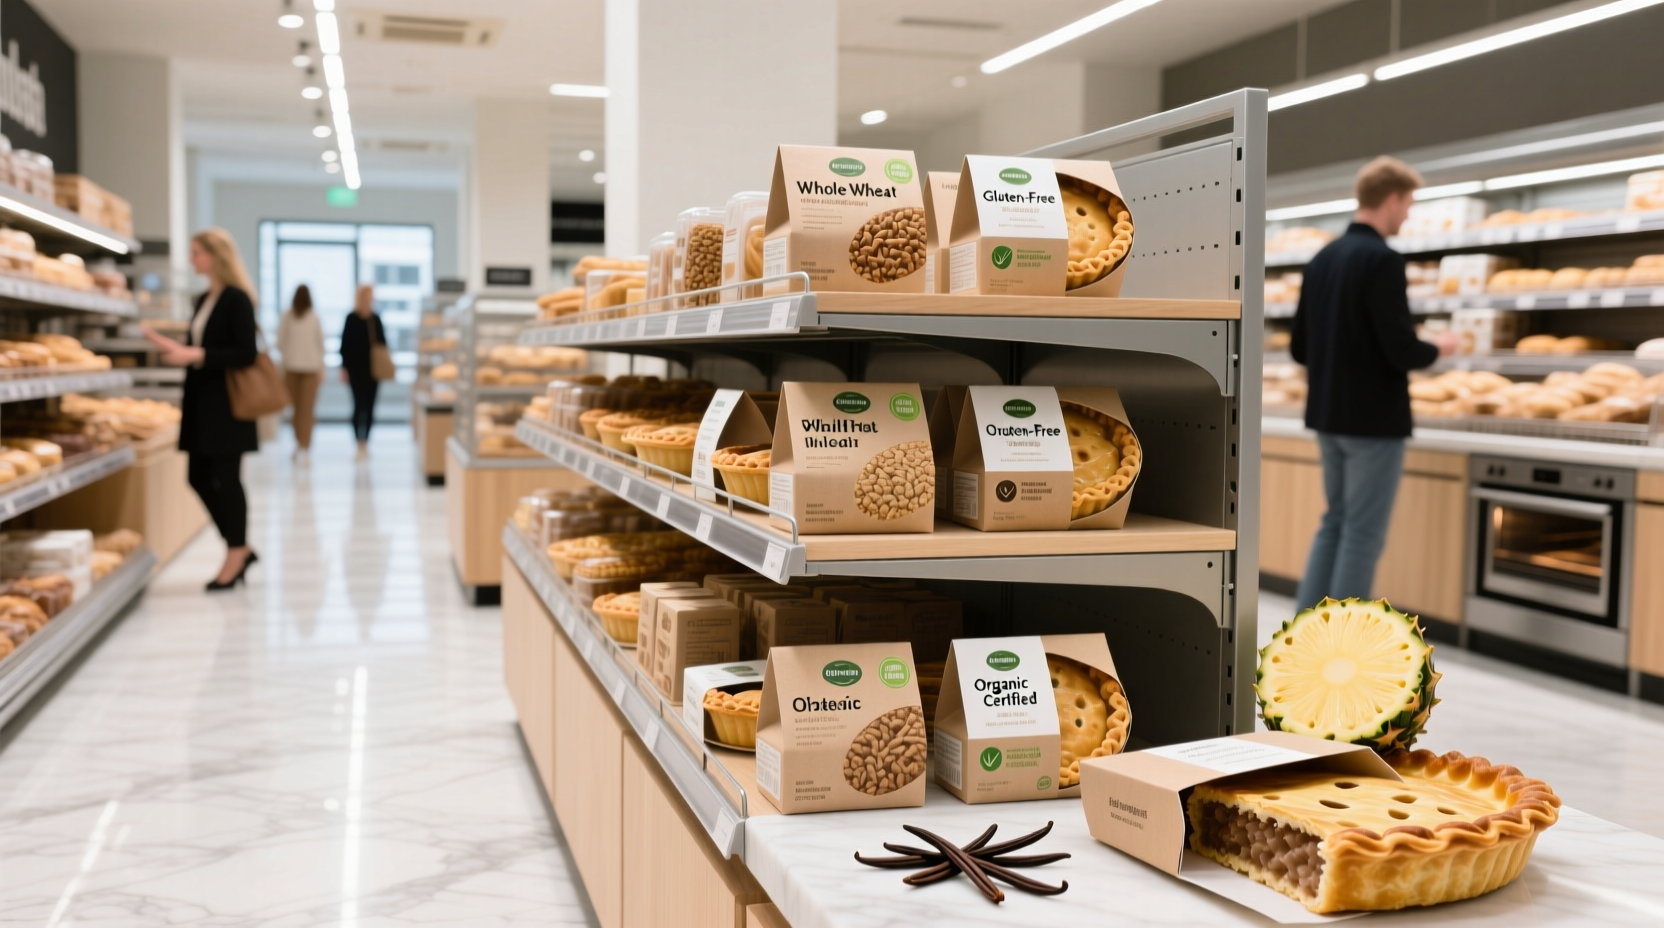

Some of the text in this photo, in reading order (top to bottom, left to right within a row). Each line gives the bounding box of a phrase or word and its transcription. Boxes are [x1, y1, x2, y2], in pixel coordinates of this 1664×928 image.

[797, 181, 897, 198] Whole Wheat
[983, 190, 1055, 204] Gluten-Free
[974, 676, 1029, 695] Organic
